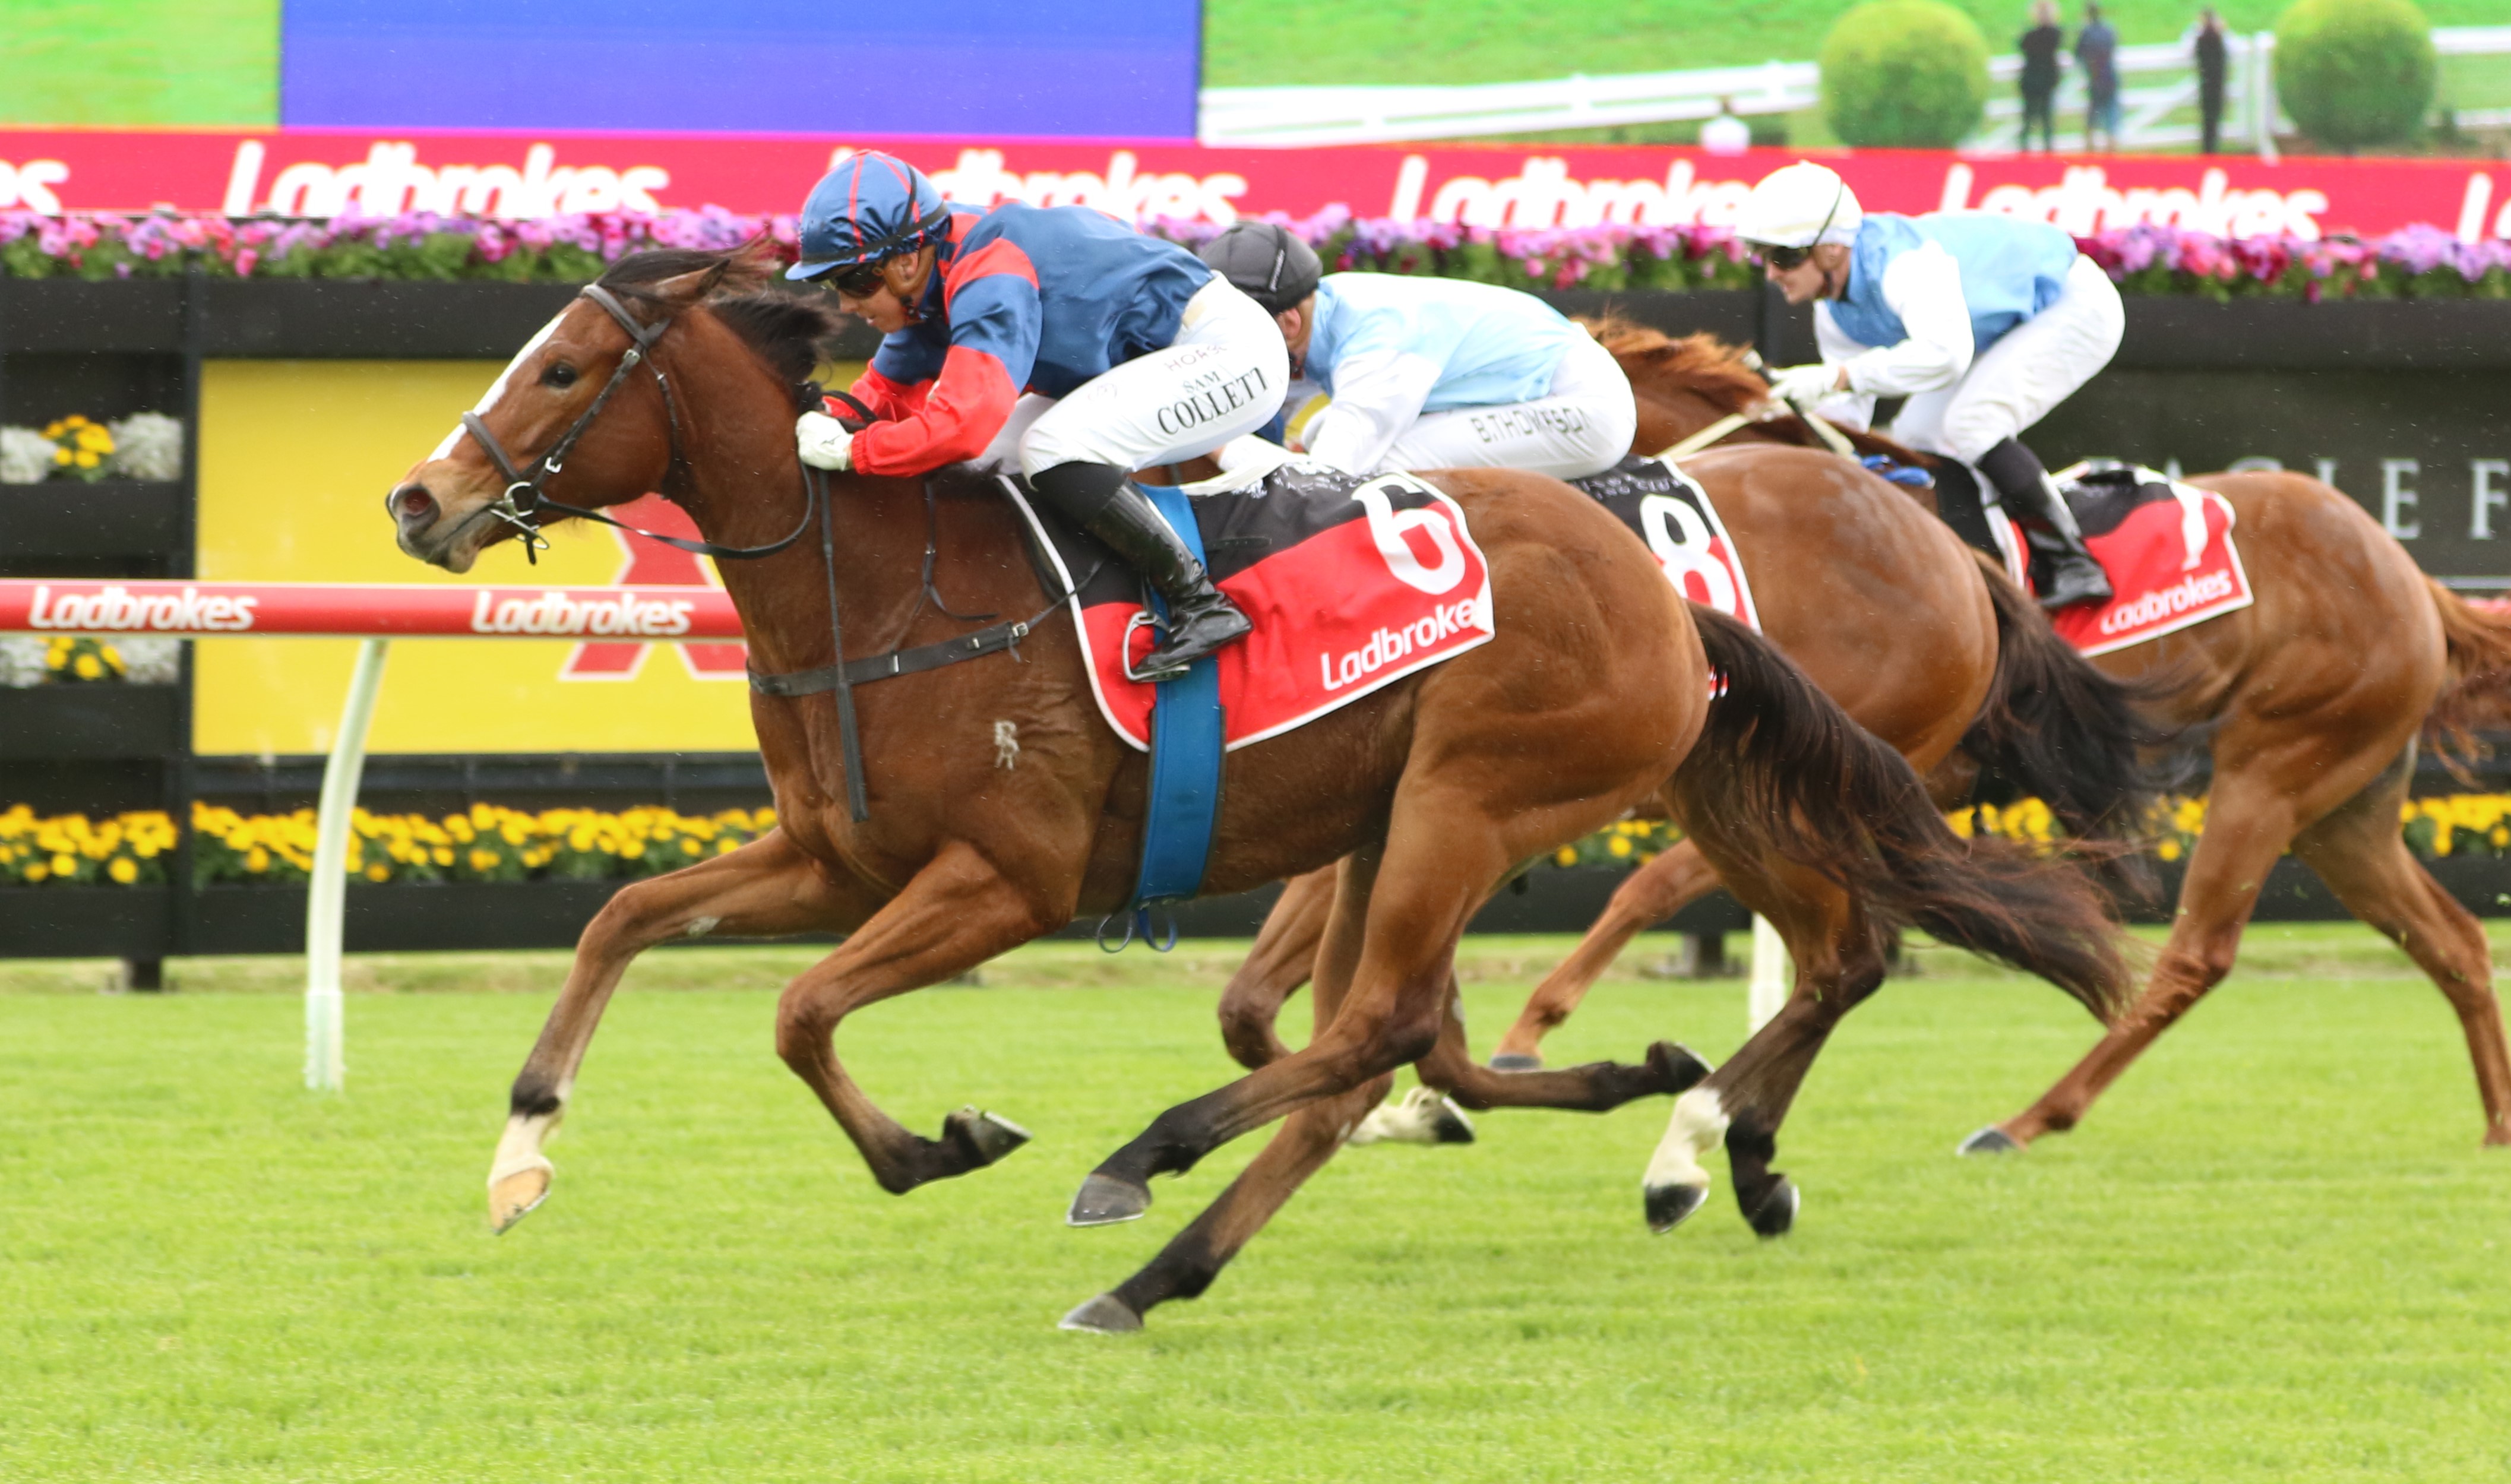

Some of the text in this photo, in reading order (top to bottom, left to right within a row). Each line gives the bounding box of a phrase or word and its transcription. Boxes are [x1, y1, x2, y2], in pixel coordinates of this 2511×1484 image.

[223, 140, 669, 217] Ladbrokes
[1182, 371, 1221, 394] SAM
[1351, 473, 1466, 594] 6
[1640, 493, 1737, 619] 8
[29, 585, 258, 632] Ladbrokes
[472, 590, 694, 636] Ladbrokes
[1320, 597, 1476, 691] Ladbroke
